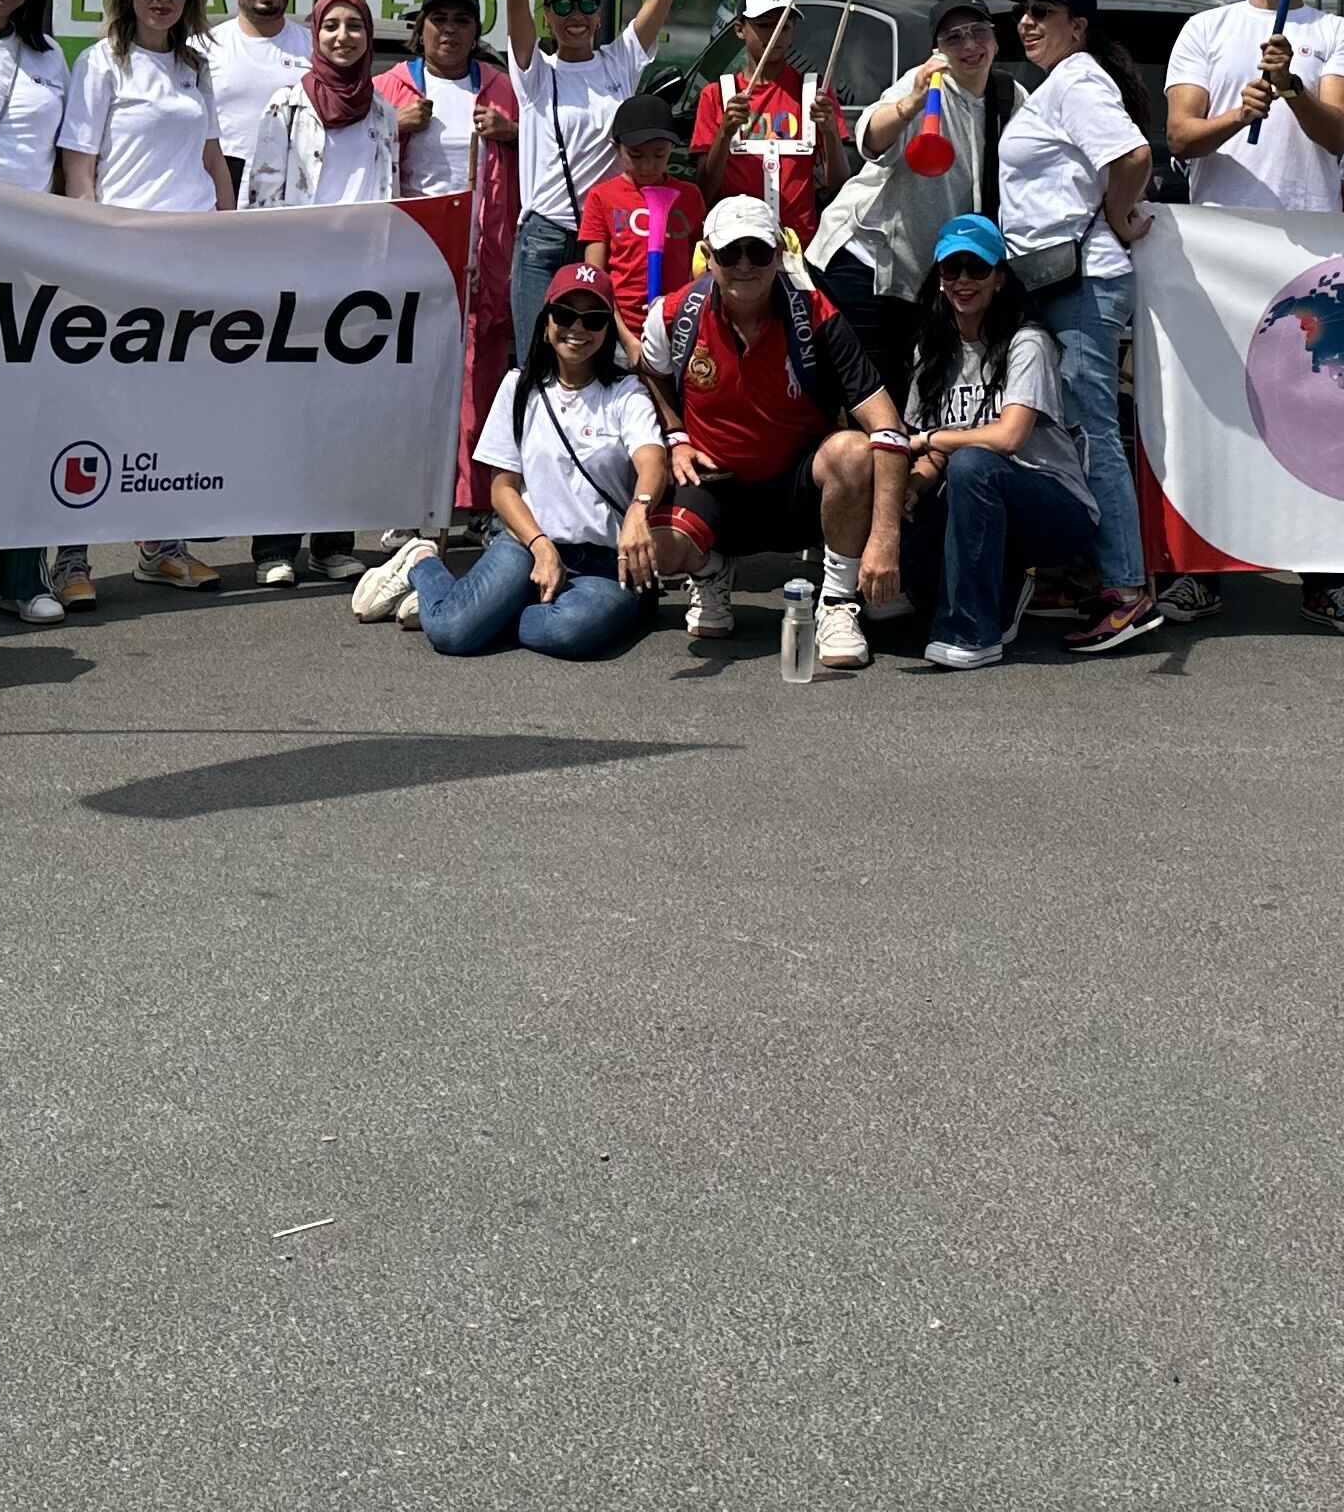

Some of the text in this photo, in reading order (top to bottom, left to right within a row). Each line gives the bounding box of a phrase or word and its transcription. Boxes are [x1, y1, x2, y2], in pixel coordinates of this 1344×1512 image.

[575, 265, 596, 283] NY
[789, 290, 813, 342] OPEN
[671, 292, 706, 368] US OPEN
[122, 453, 158, 472] LCI
[120, 472, 224, 493] Education
